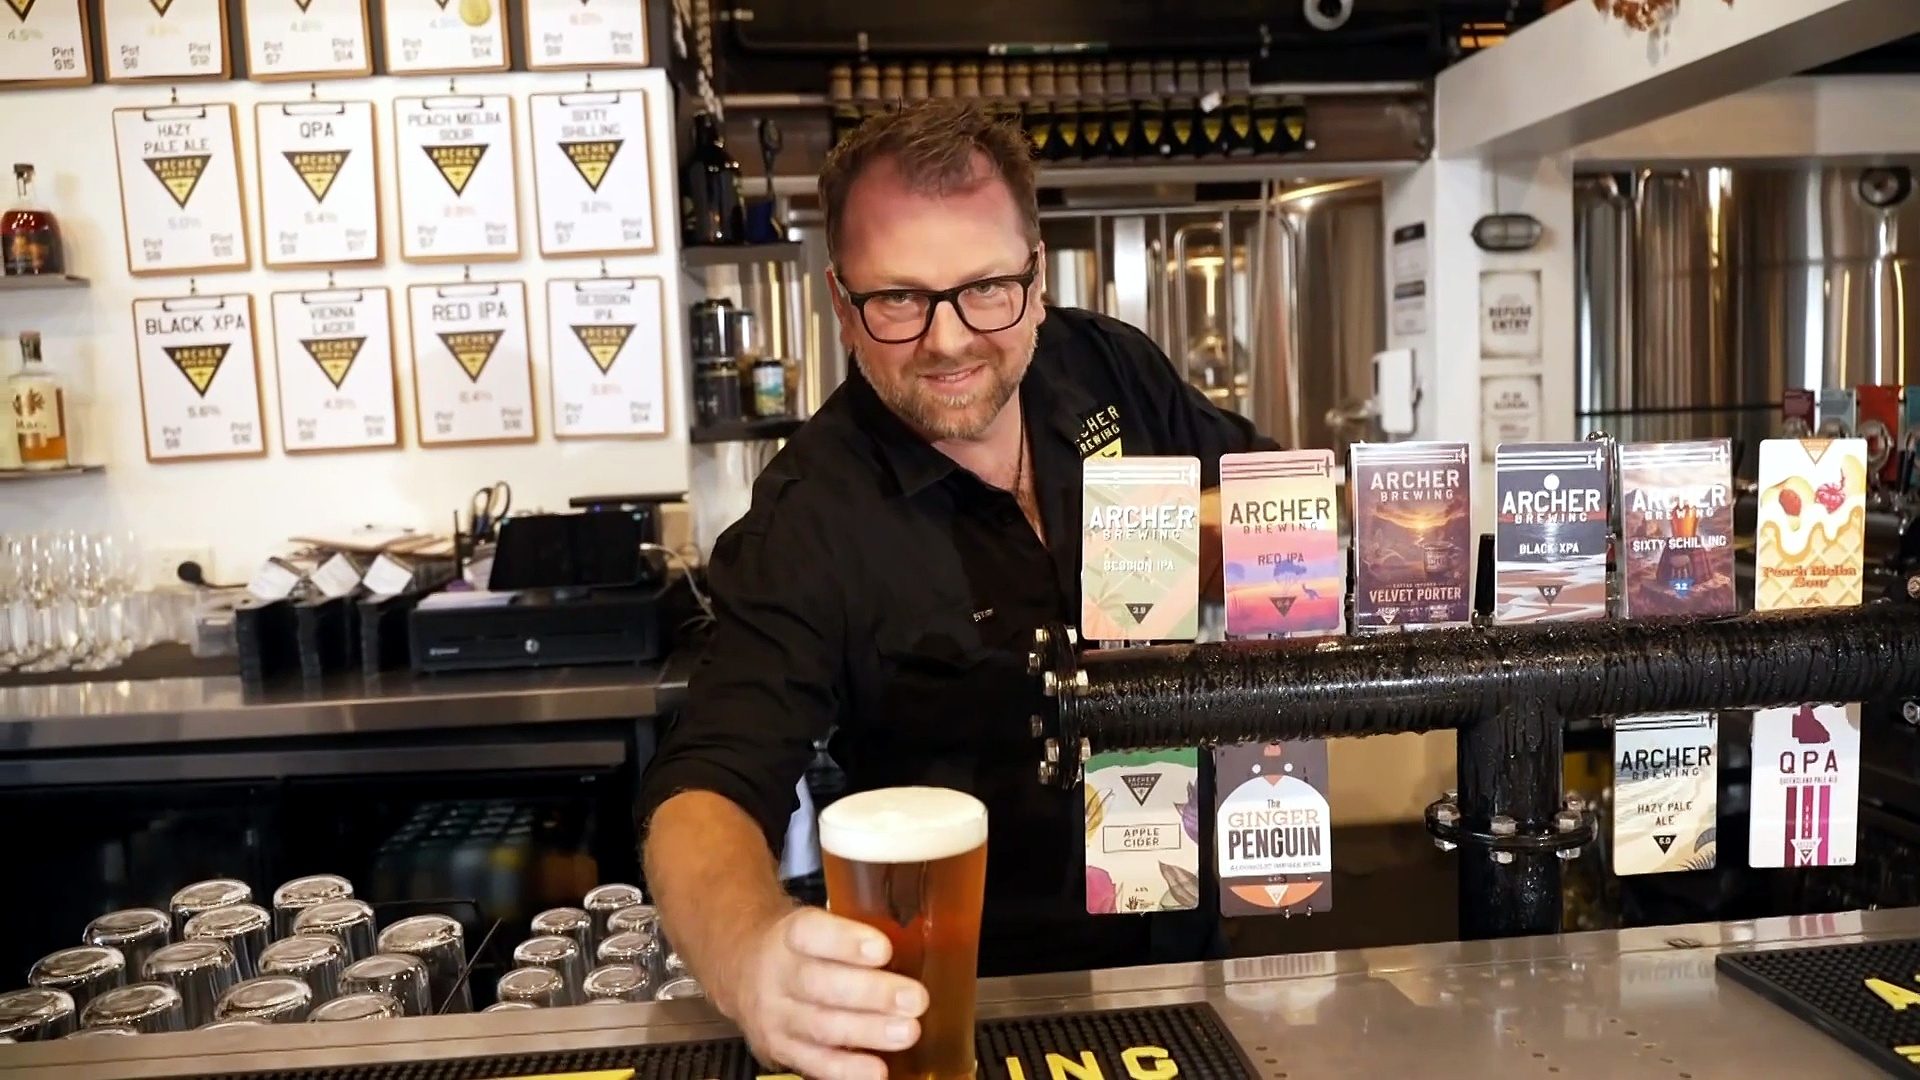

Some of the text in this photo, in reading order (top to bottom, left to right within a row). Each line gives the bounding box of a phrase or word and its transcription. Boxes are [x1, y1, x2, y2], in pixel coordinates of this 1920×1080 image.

[407, 112, 501, 126] PEACH MELBA
[572, 109, 607, 122] SIXTY
[158, 123, 191, 137] HAZY
[300, 121, 335, 138] QPA
[439, 128, 474, 140] SOUR
[561, 123, 621, 138] SHILLING
[144, 138, 210, 153] PALE ALE
[309, 306, 354, 320] VIENNA
[431, 302, 508, 321] RED IPA
[145, 314, 246, 336] BLACK XPA
[311, 321, 355, 335] LAGER
[1491, 319, 1530, 331] ENTRY
[1076, 423, 1120, 455] REWING
[1370, 469, 1460, 491] ARCHER
[1380, 489, 1454, 502] BREWING
[1502, 488, 1601, 514] ARCHER
[1632, 484, 1727, 512] ARCHER
[1089, 505, 1197, 530] ARCHER
[1229, 498, 1331, 525] ARCHER
[1514, 512, 1589, 525] BREWING
[1645, 508, 1715, 521] BREWING
[1103, 528, 1181, 541] BREWING
[1243, 521, 1318, 534] BREWING
[1519, 543, 1579, 555] BLACK XPA
[1632, 535, 1727, 552] SIXTY SCHILLING
[1103, 560, 1176, 572] SESSION IPA
[1257, 552, 1305, 566] RED IPA
[1762, 564, 1857, 577] Peach Melba
[1369, 587, 1461, 604] VELVET PORTER
[1620, 745, 1711, 772] ARCHER
[1780, 750, 1838, 774] QPA
[1632, 767, 1700, 781] BREWING
[1267, 798, 1281, 809] The
[1637, 800, 1693, 815] HAZY PALE
[1227, 808, 1320, 828] GINGER
[1655, 815, 1675, 826] ALE
[1123, 827, 1160, 838] APPLE
[1123, 838, 1160, 848] CIDER
[1227, 826, 1321, 860] PENGUIN
